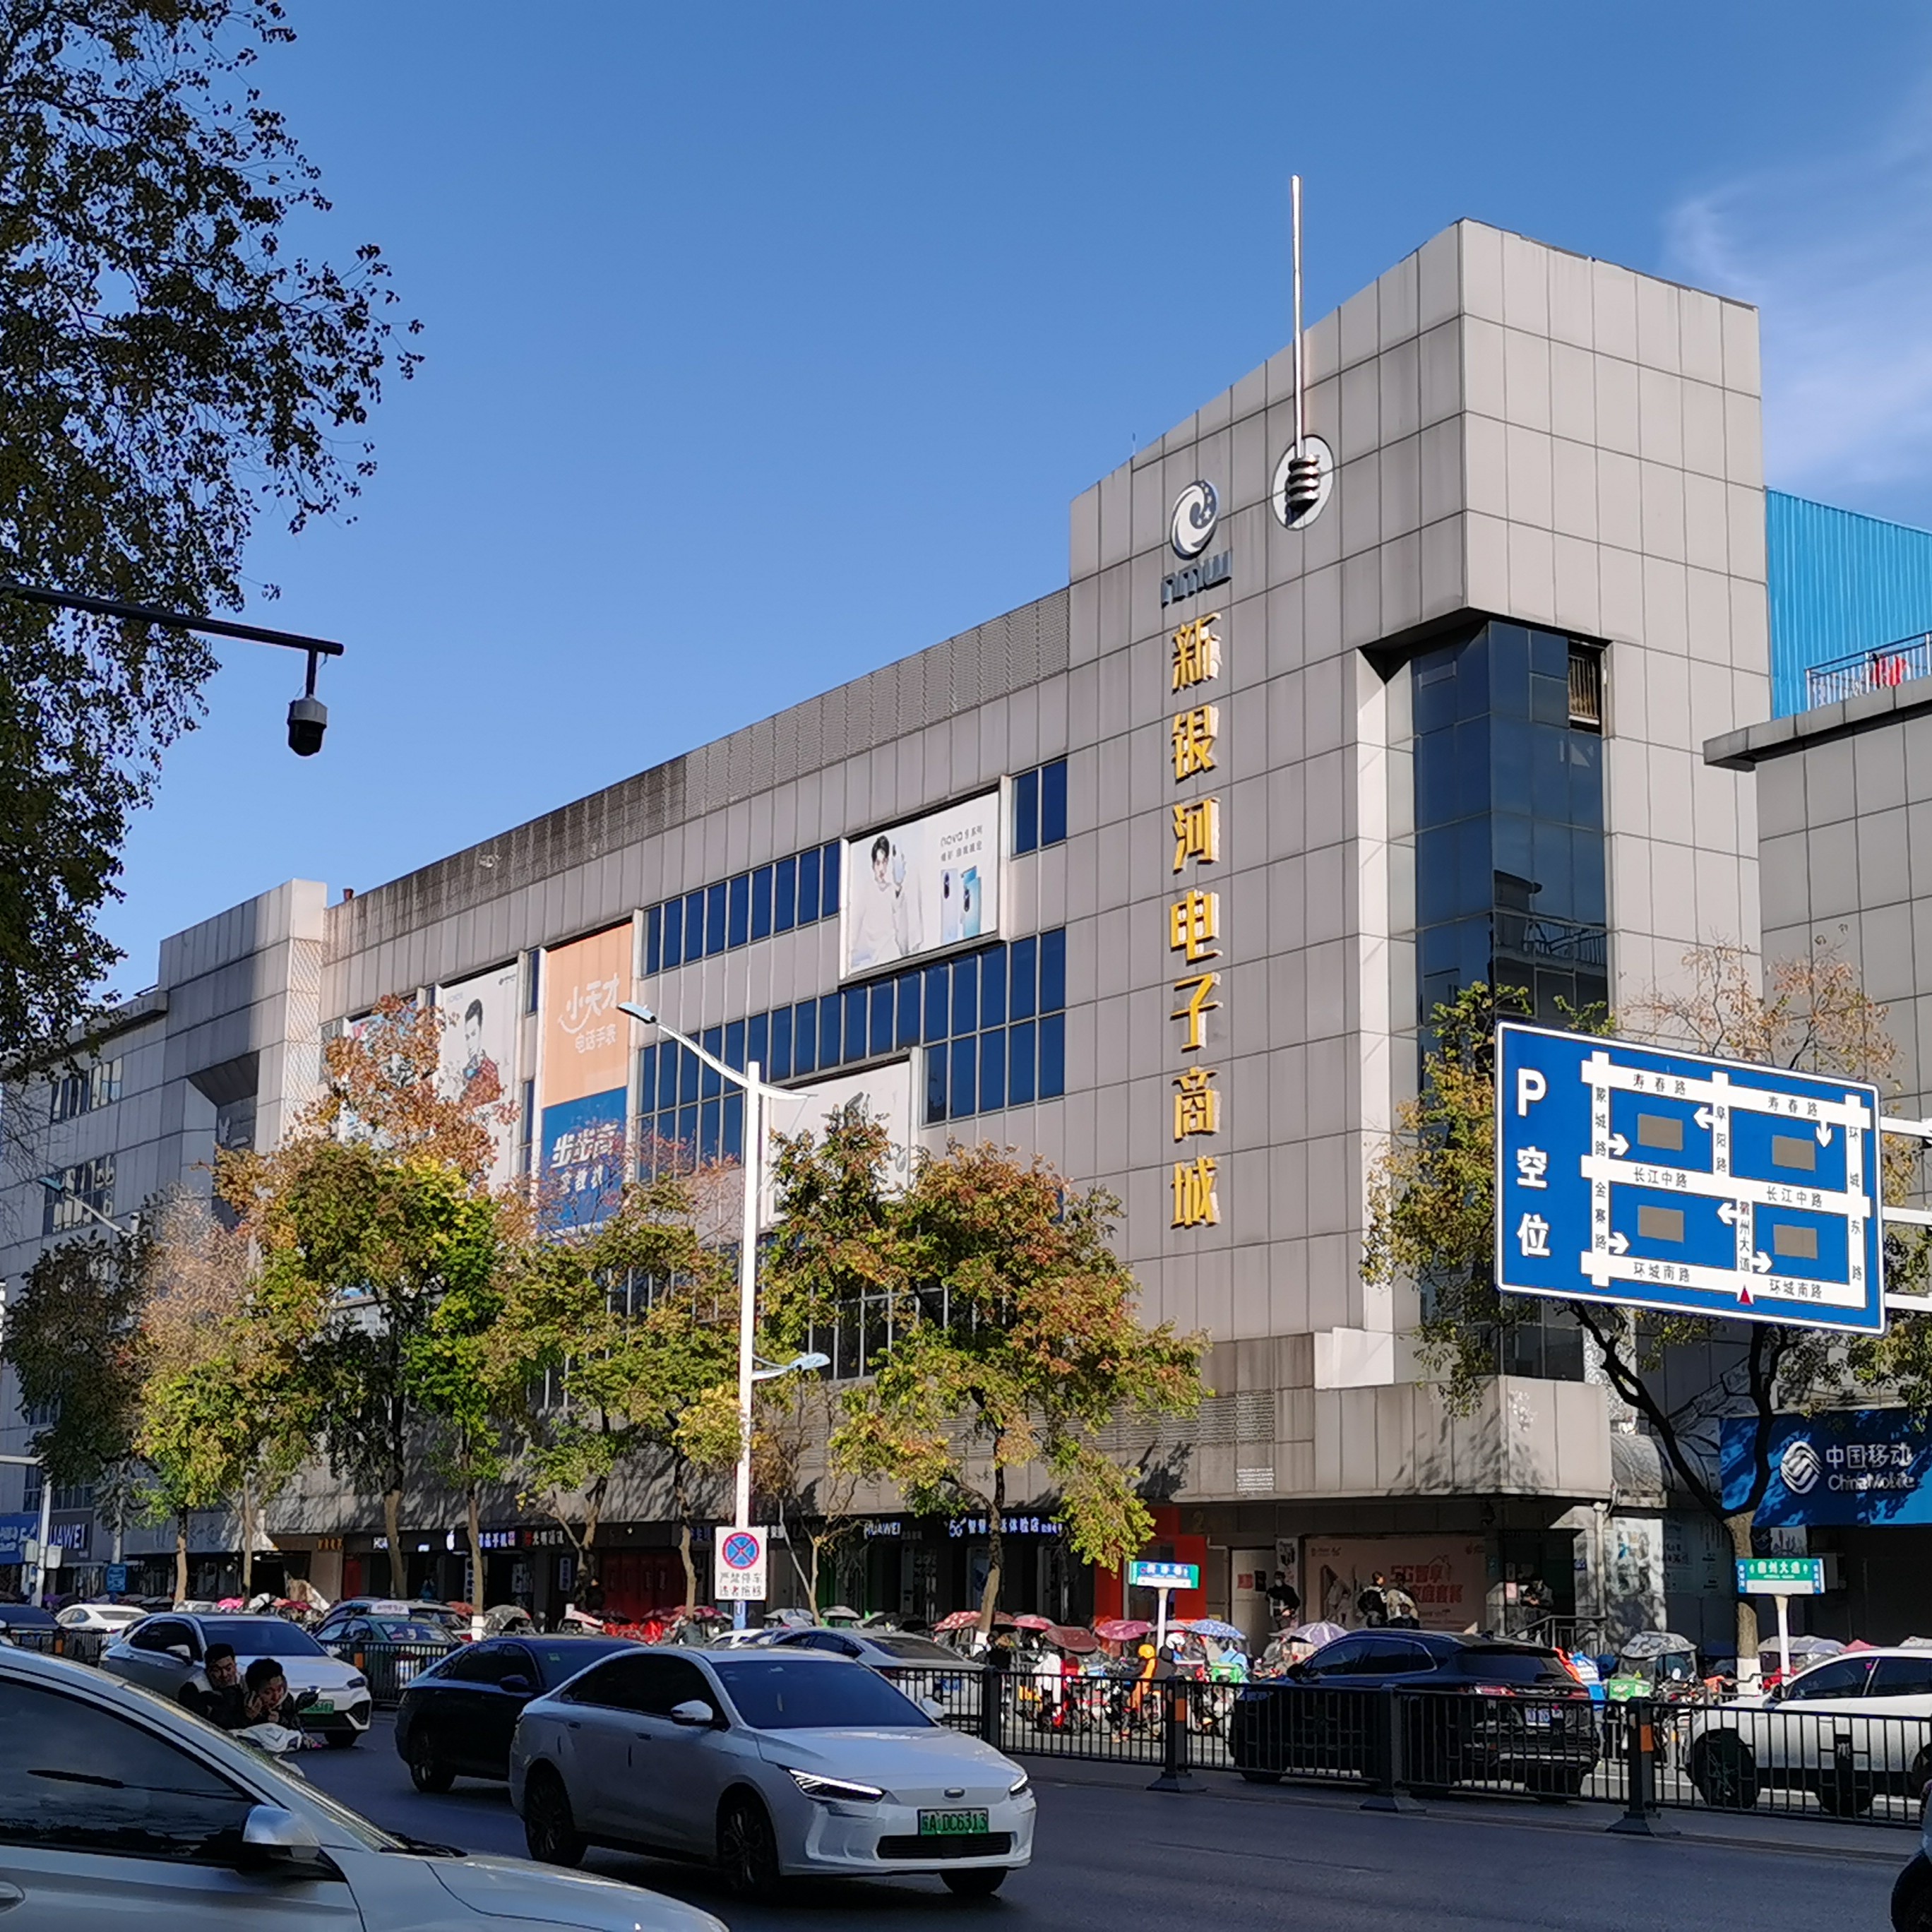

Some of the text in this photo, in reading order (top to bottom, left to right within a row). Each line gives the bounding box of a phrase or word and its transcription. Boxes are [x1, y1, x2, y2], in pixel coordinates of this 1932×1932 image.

[1169, 612, 1222, 1229] 新银河电子商城
[559, 972, 620, 1034] 小天才
[576, 1024, 616, 1054] 电话手表
[1633, 1073, 1686, 1096] 寿春路
[1767, 1095, 1818, 1117] 寿春路
[1715, 1105, 1727, 1173] 阜阳路
[1633, 1167, 1687, 1189] 长江中路
[1766, 1186, 1823, 1208] 长江中路
[1849, 1126, 1863, 1281] 环城东路
[1594, 1182, 1607, 1250] 金寨路
[1739, 1202, 1751, 1273] 徽州大道
[1633, 1261, 1690, 1284] 环城南路
[1769, 1278, 1823, 1299] 环城南路
[1826, 1443, 1912, 1469] 中国移动
[49, 1524, 85, 1549] UAWEI
